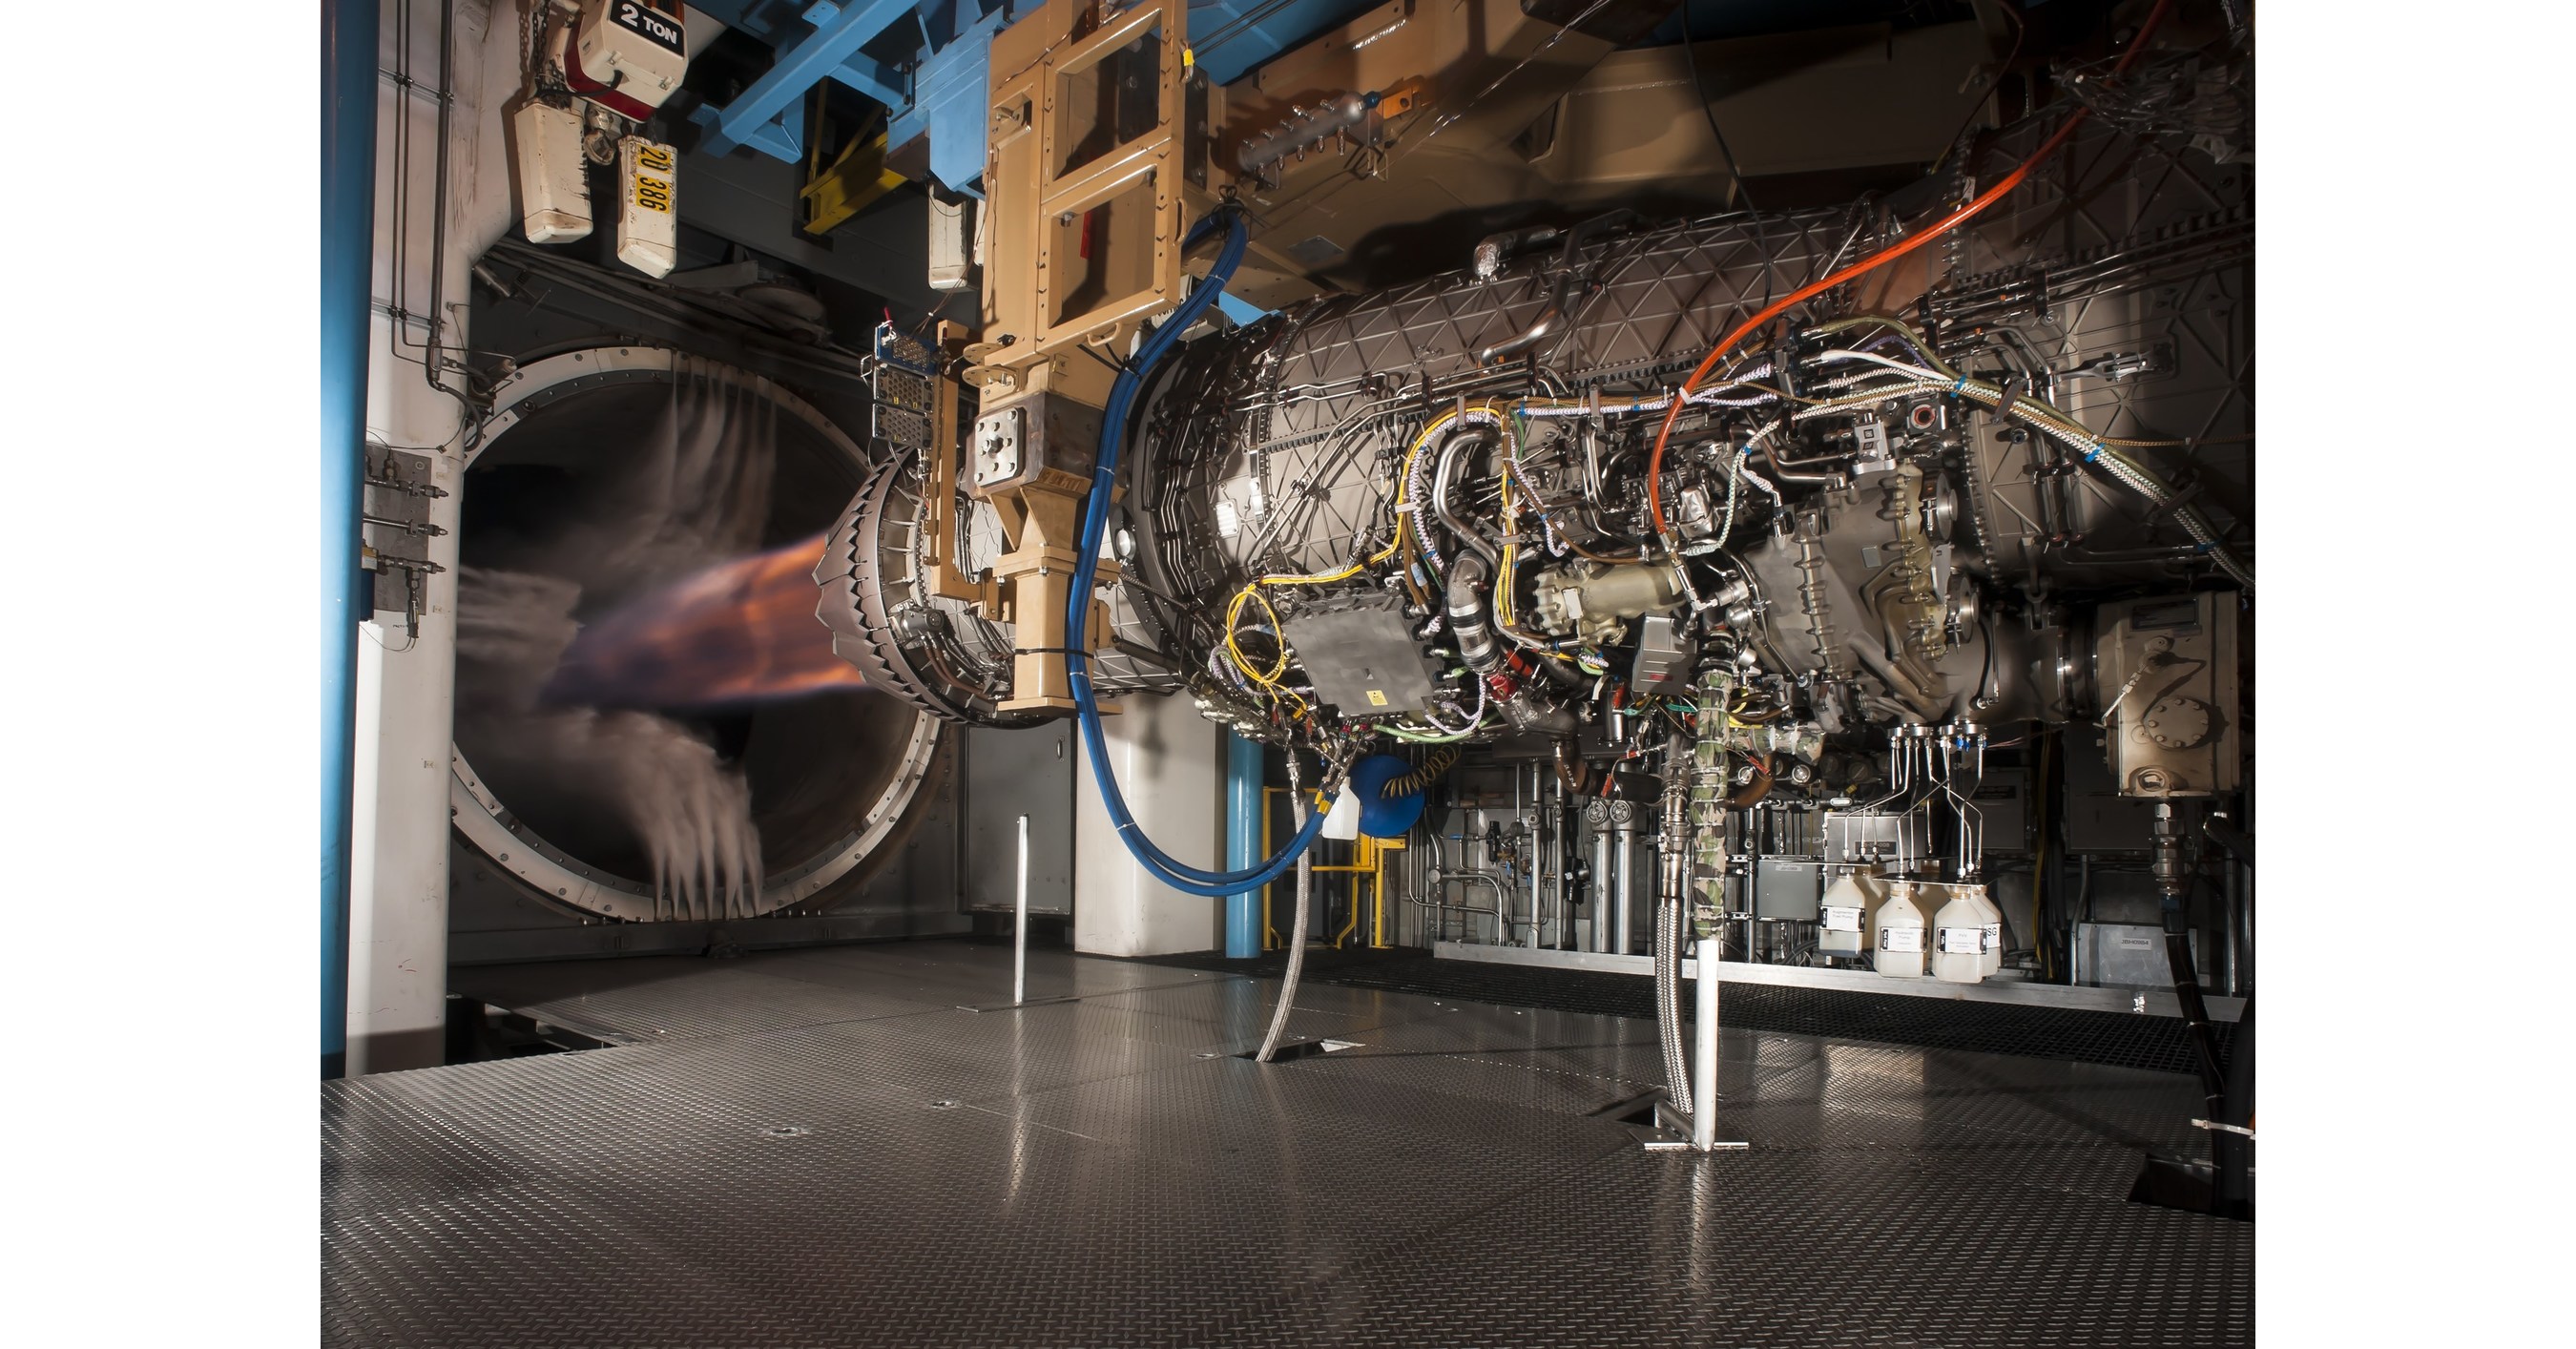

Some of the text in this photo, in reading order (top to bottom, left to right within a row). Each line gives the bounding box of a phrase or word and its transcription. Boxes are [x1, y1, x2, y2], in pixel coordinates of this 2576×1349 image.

[621, 3, 677, 45] 2 TON
[639, 146, 668, 212] 20 386
